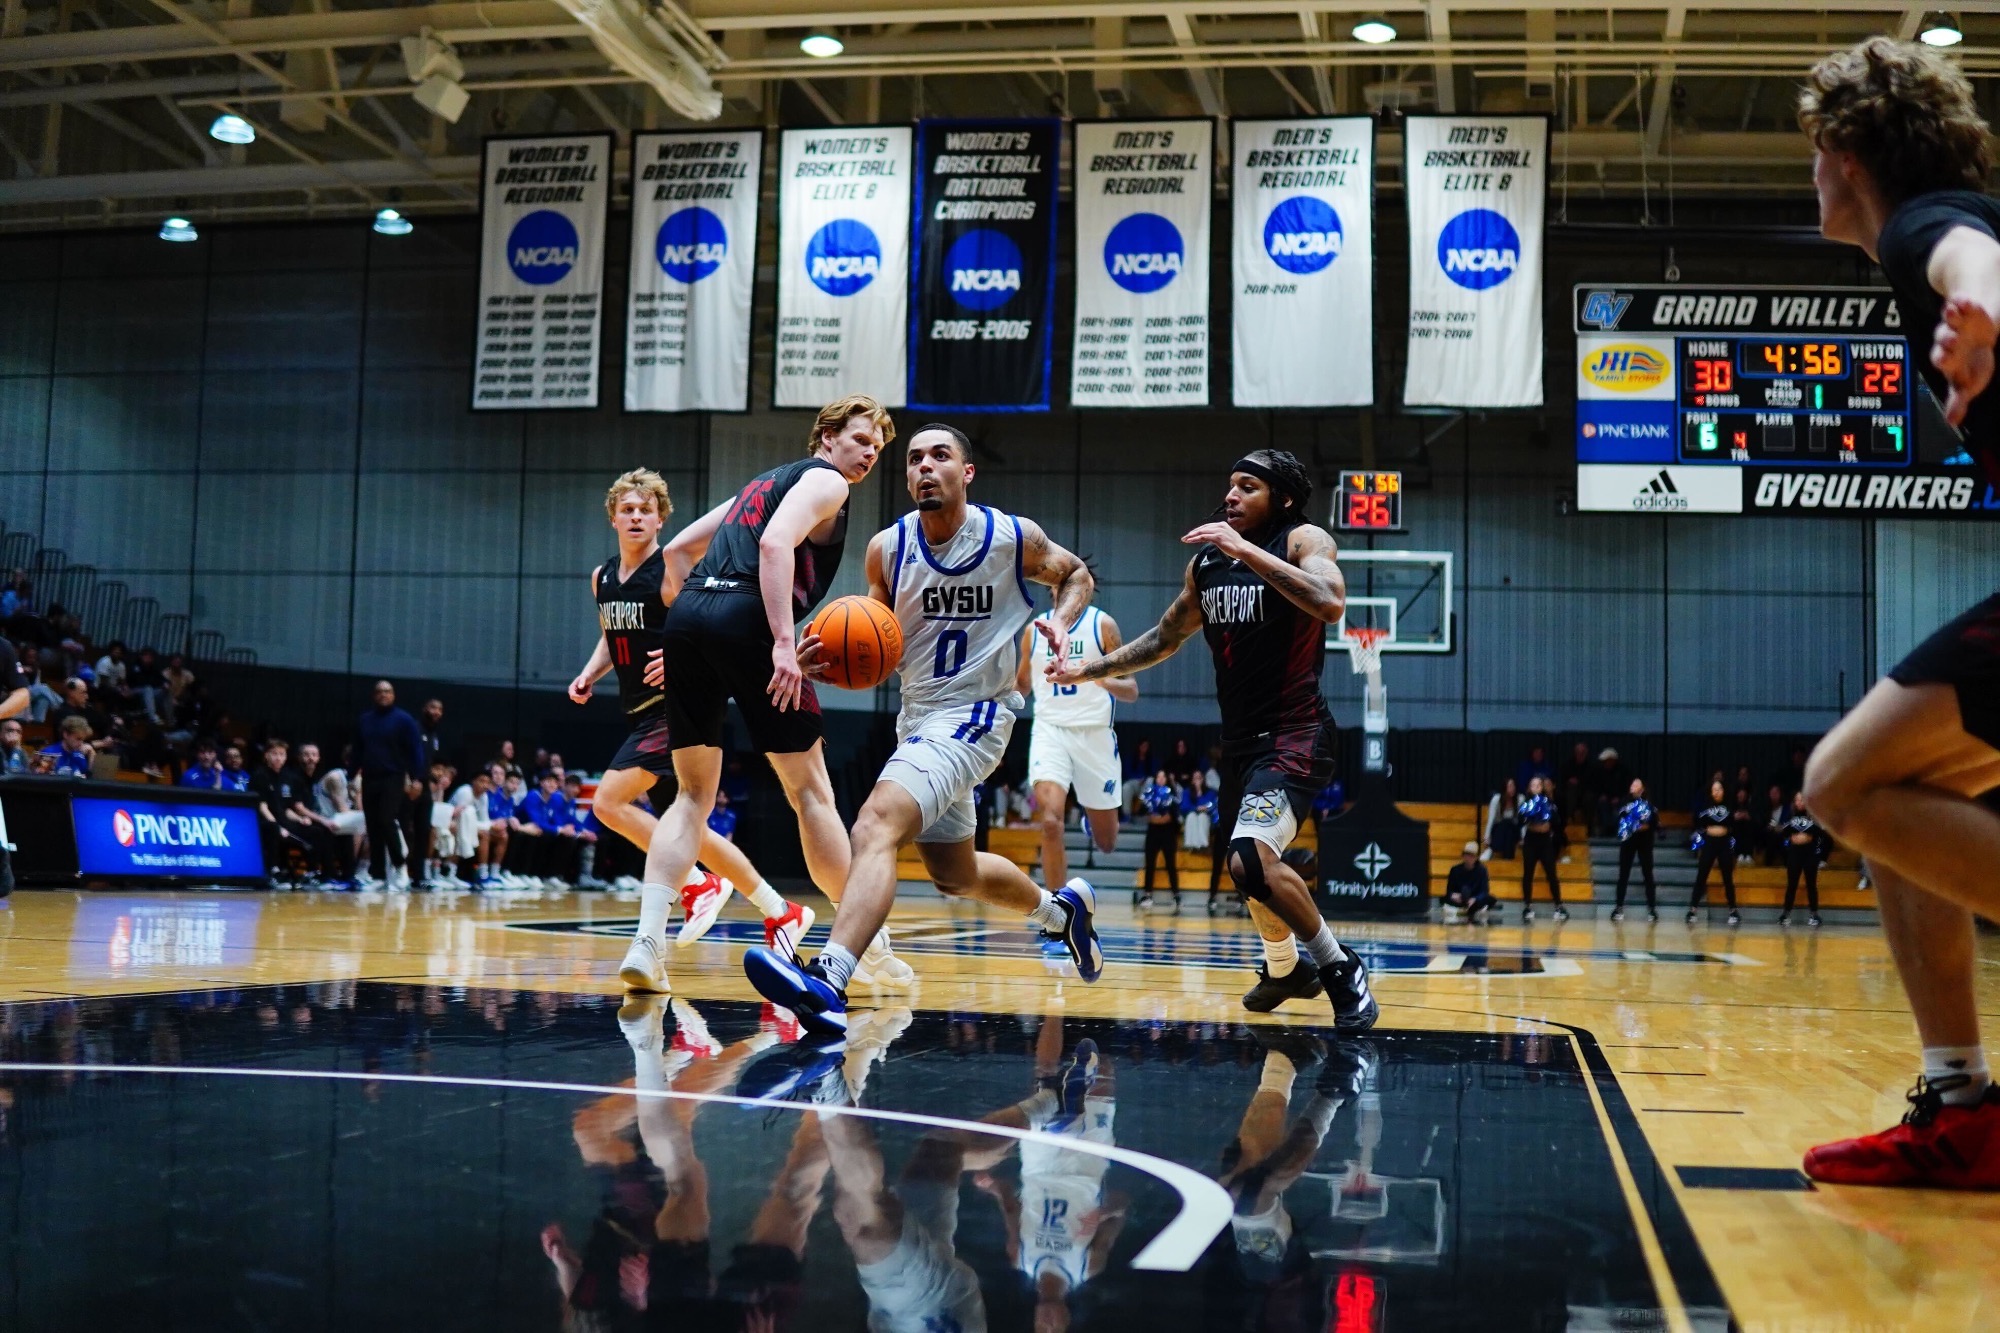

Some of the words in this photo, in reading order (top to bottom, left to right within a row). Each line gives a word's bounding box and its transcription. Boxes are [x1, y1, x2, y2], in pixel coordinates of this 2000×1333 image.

[946, 132, 1031, 150] WOMEN'S
[1113, 131, 1174, 149] MEN'S
[1273, 128, 1332, 146] MEN'S
[1448, 126, 1508, 144] MEN'S
[509, 146, 589, 163] WOMEN'S
[657, 142, 739, 159] WOMEN'S
[805, 137, 888, 155] WOMEN'S
[934, 155, 1041, 174] BASKETBALL
[1090, 153, 1198, 172] BASKETBALL
[1246, 148, 1359, 168] BASKETBALL
[1424, 150, 1531, 167] BASKETBALL
[495, 165, 598, 184] BASKETBALL
[642, 162, 747, 180] BASKETBALL
[795, 160, 896, 177] BASKETBALL
[945, 178, 1026, 197] NATIONAL
[1103, 177, 1184, 195] REGIONAL
[1259, 171, 1346, 188] REGIONAL
[1444, 173, 1494, 191] ELITE
[1499, 173, 1513, 191] 8
[504, 186, 584, 204] REGIONAL
[654, 183, 735, 200] REGIONAL
[813, 183, 859, 199] ELITE
[866, 182, 878, 199] 8
[934, 201, 1036, 220] CHAMPIONS
[1270, 231, 1341, 256] NCAA
[514, 247, 575, 267] NCAA
[664, 244, 725, 264] NCAA
[1446, 248, 1517, 272] NCAA
[812, 256, 879, 278] NCAA
[1112, 252, 1181, 275] NCAA
[952, 269, 1021, 291] NCAA
[1653, 295, 1758, 326] GRAND
[1770, 296, 1877, 328] VALLEY
[931, 320, 1031, 340] 2005-2006
[1688, 342, 1729, 357] HOME
[1851, 343, 1904, 360] VISITOR
[1764, 343, 1841, 375] 4:56
[1694, 360, 1731, 391] 30
[1864, 362, 1901, 393] 22
[1706, 394, 1740, 407] BONUS
[1765, 388, 1802, 401] PERIOD
[1814, 384, 1823, 410] 1
[1848, 396, 1882, 409] BONUS
[1686, 412, 1718, 425] FOULS
[1756, 413, 1794, 426] PLAYER
[1809, 414, 1841, 427] FOULS
[1871, 415, 1903, 428] FOULS
[1599, 424, 1628, 438] PNC
[1631, 424, 1669, 438] BANK
[1700, 422, 1718, 450] 6
[1887, 426, 1903, 451] 7
[1734, 431, 1747, 450] 4
[1842, 433, 1855, 450] 4
[1731, 449, 1750, 462] TOL
[1839, 450, 1858, 463] TOL
[1352, 473, 1399, 493] 4:56
[1632, 494, 1688, 508] adidas
[1349, 494, 1390, 528] 26
[922, 585, 993, 614] GVSU
[615, 637, 630, 664] 11
[934, 630, 968, 678] 0
[134, 813, 179, 845] PNC
[177, 816, 230, 847] BANK
[1326, 879, 1369, 899] Trinity
[1371, 882, 1418, 897] Health
